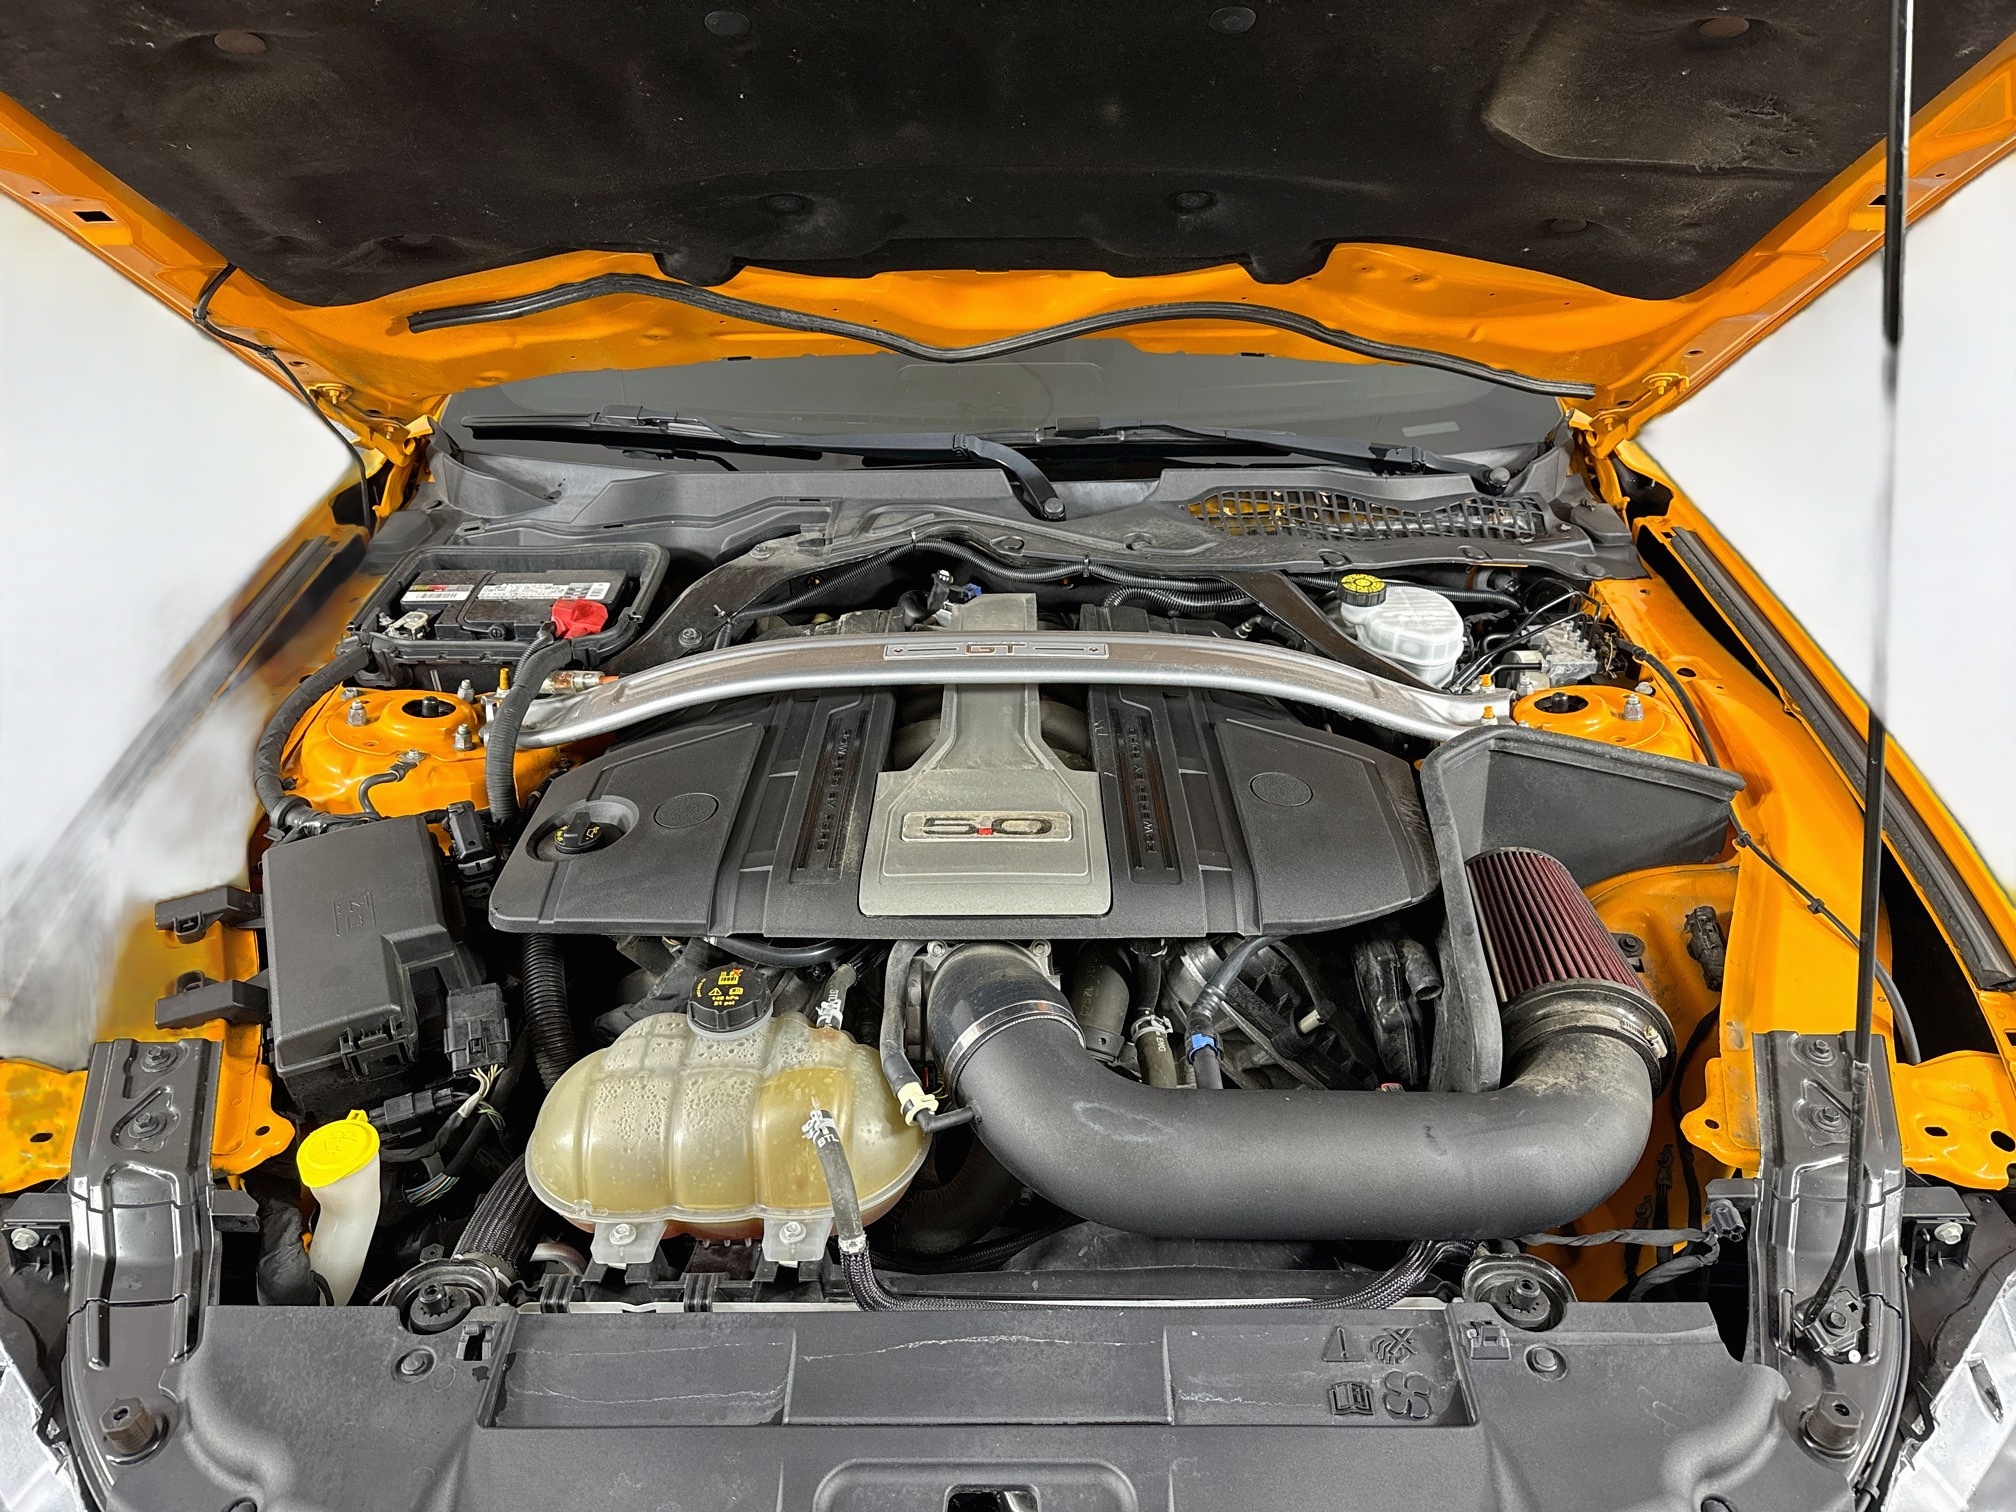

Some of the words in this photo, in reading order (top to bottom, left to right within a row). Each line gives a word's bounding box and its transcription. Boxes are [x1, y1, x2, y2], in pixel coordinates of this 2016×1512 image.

[965, 642, 1026, 655] GT
[923, 818, 1052, 835] 5.0
[817, 1133, 840, 1149] BTL
